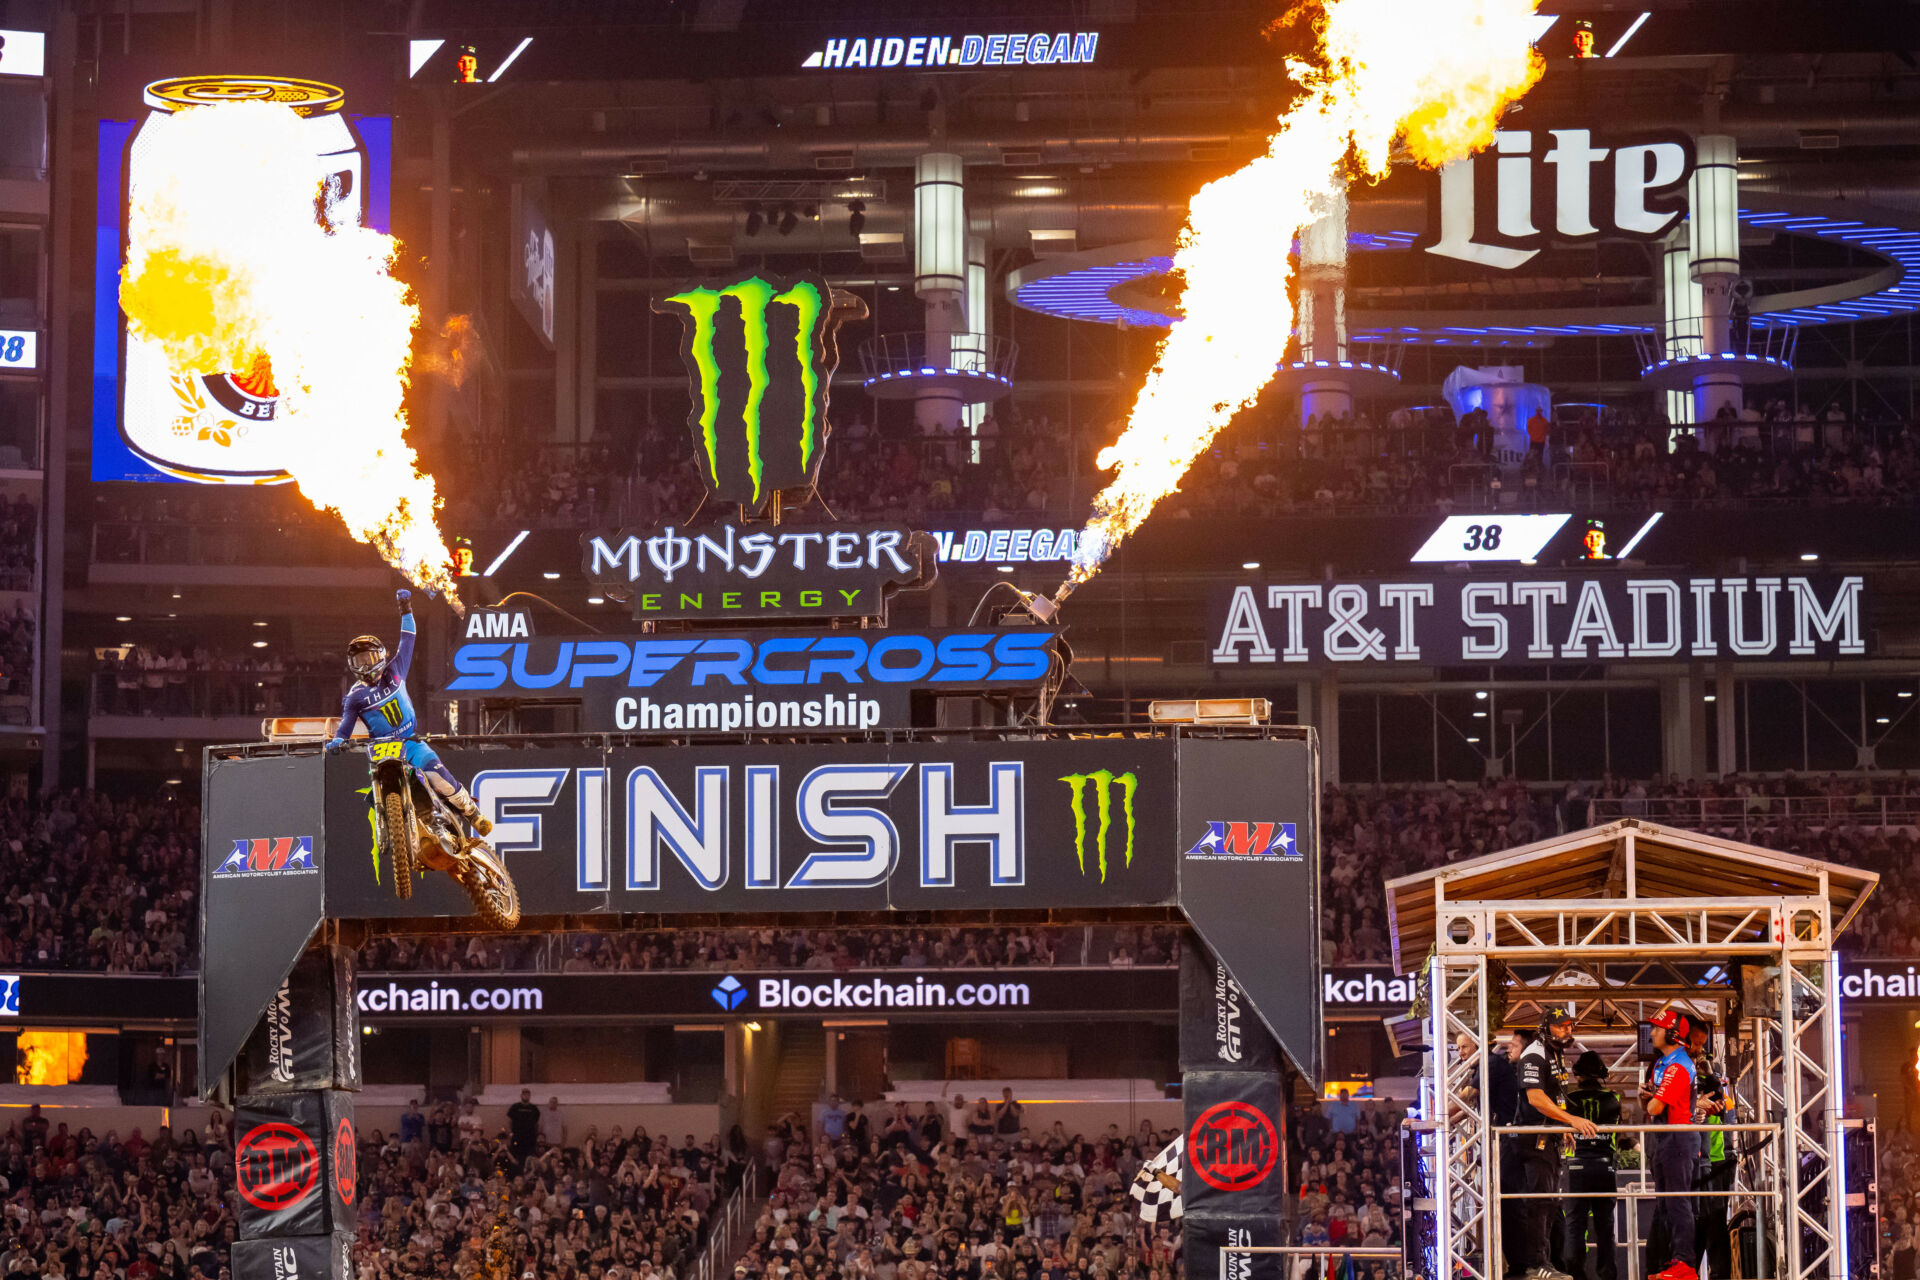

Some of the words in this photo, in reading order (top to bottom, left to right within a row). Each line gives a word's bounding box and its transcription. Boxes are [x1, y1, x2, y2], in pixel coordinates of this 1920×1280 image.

[823, 37, 951, 68] HAIDEN
[958, 32, 1098, 66] DEEGAN
[1424, 129, 1685, 269] Lite
[239, 400, 271, 418] BE
[588, 525, 912, 583] MONSTER
[961, 528, 1077, 562] DEEGA
[1463, 524, 1502, 551] 38
[642, 589, 861, 611] ENERGY
[465, 612, 530, 639] AMA
[1213, 583, 1434, 663] AT&T
[1461, 576, 1866, 660] STADIUM
[445, 633, 1055, 690] SUPERCROSS
[615, 693, 881, 732] Championship
[371, 741, 403, 761] 38
[471, 761, 1025, 892] FINISH
[1184, 821, 1304, 857] AMA
[212, 835, 319, 873] AMA
[357, 981, 543, 1011] kchain.com
[759, 976, 1030, 1008] Blockchain.com
[1216, 963, 1226, 1001] MOUN
[1216, 1003, 1227, 1043] ROCKY
[268, 1026, 280, 1065] ROCKY
[1206, 1128, 1260, 1165] RM
[247, 1147, 305, 1185] RM
